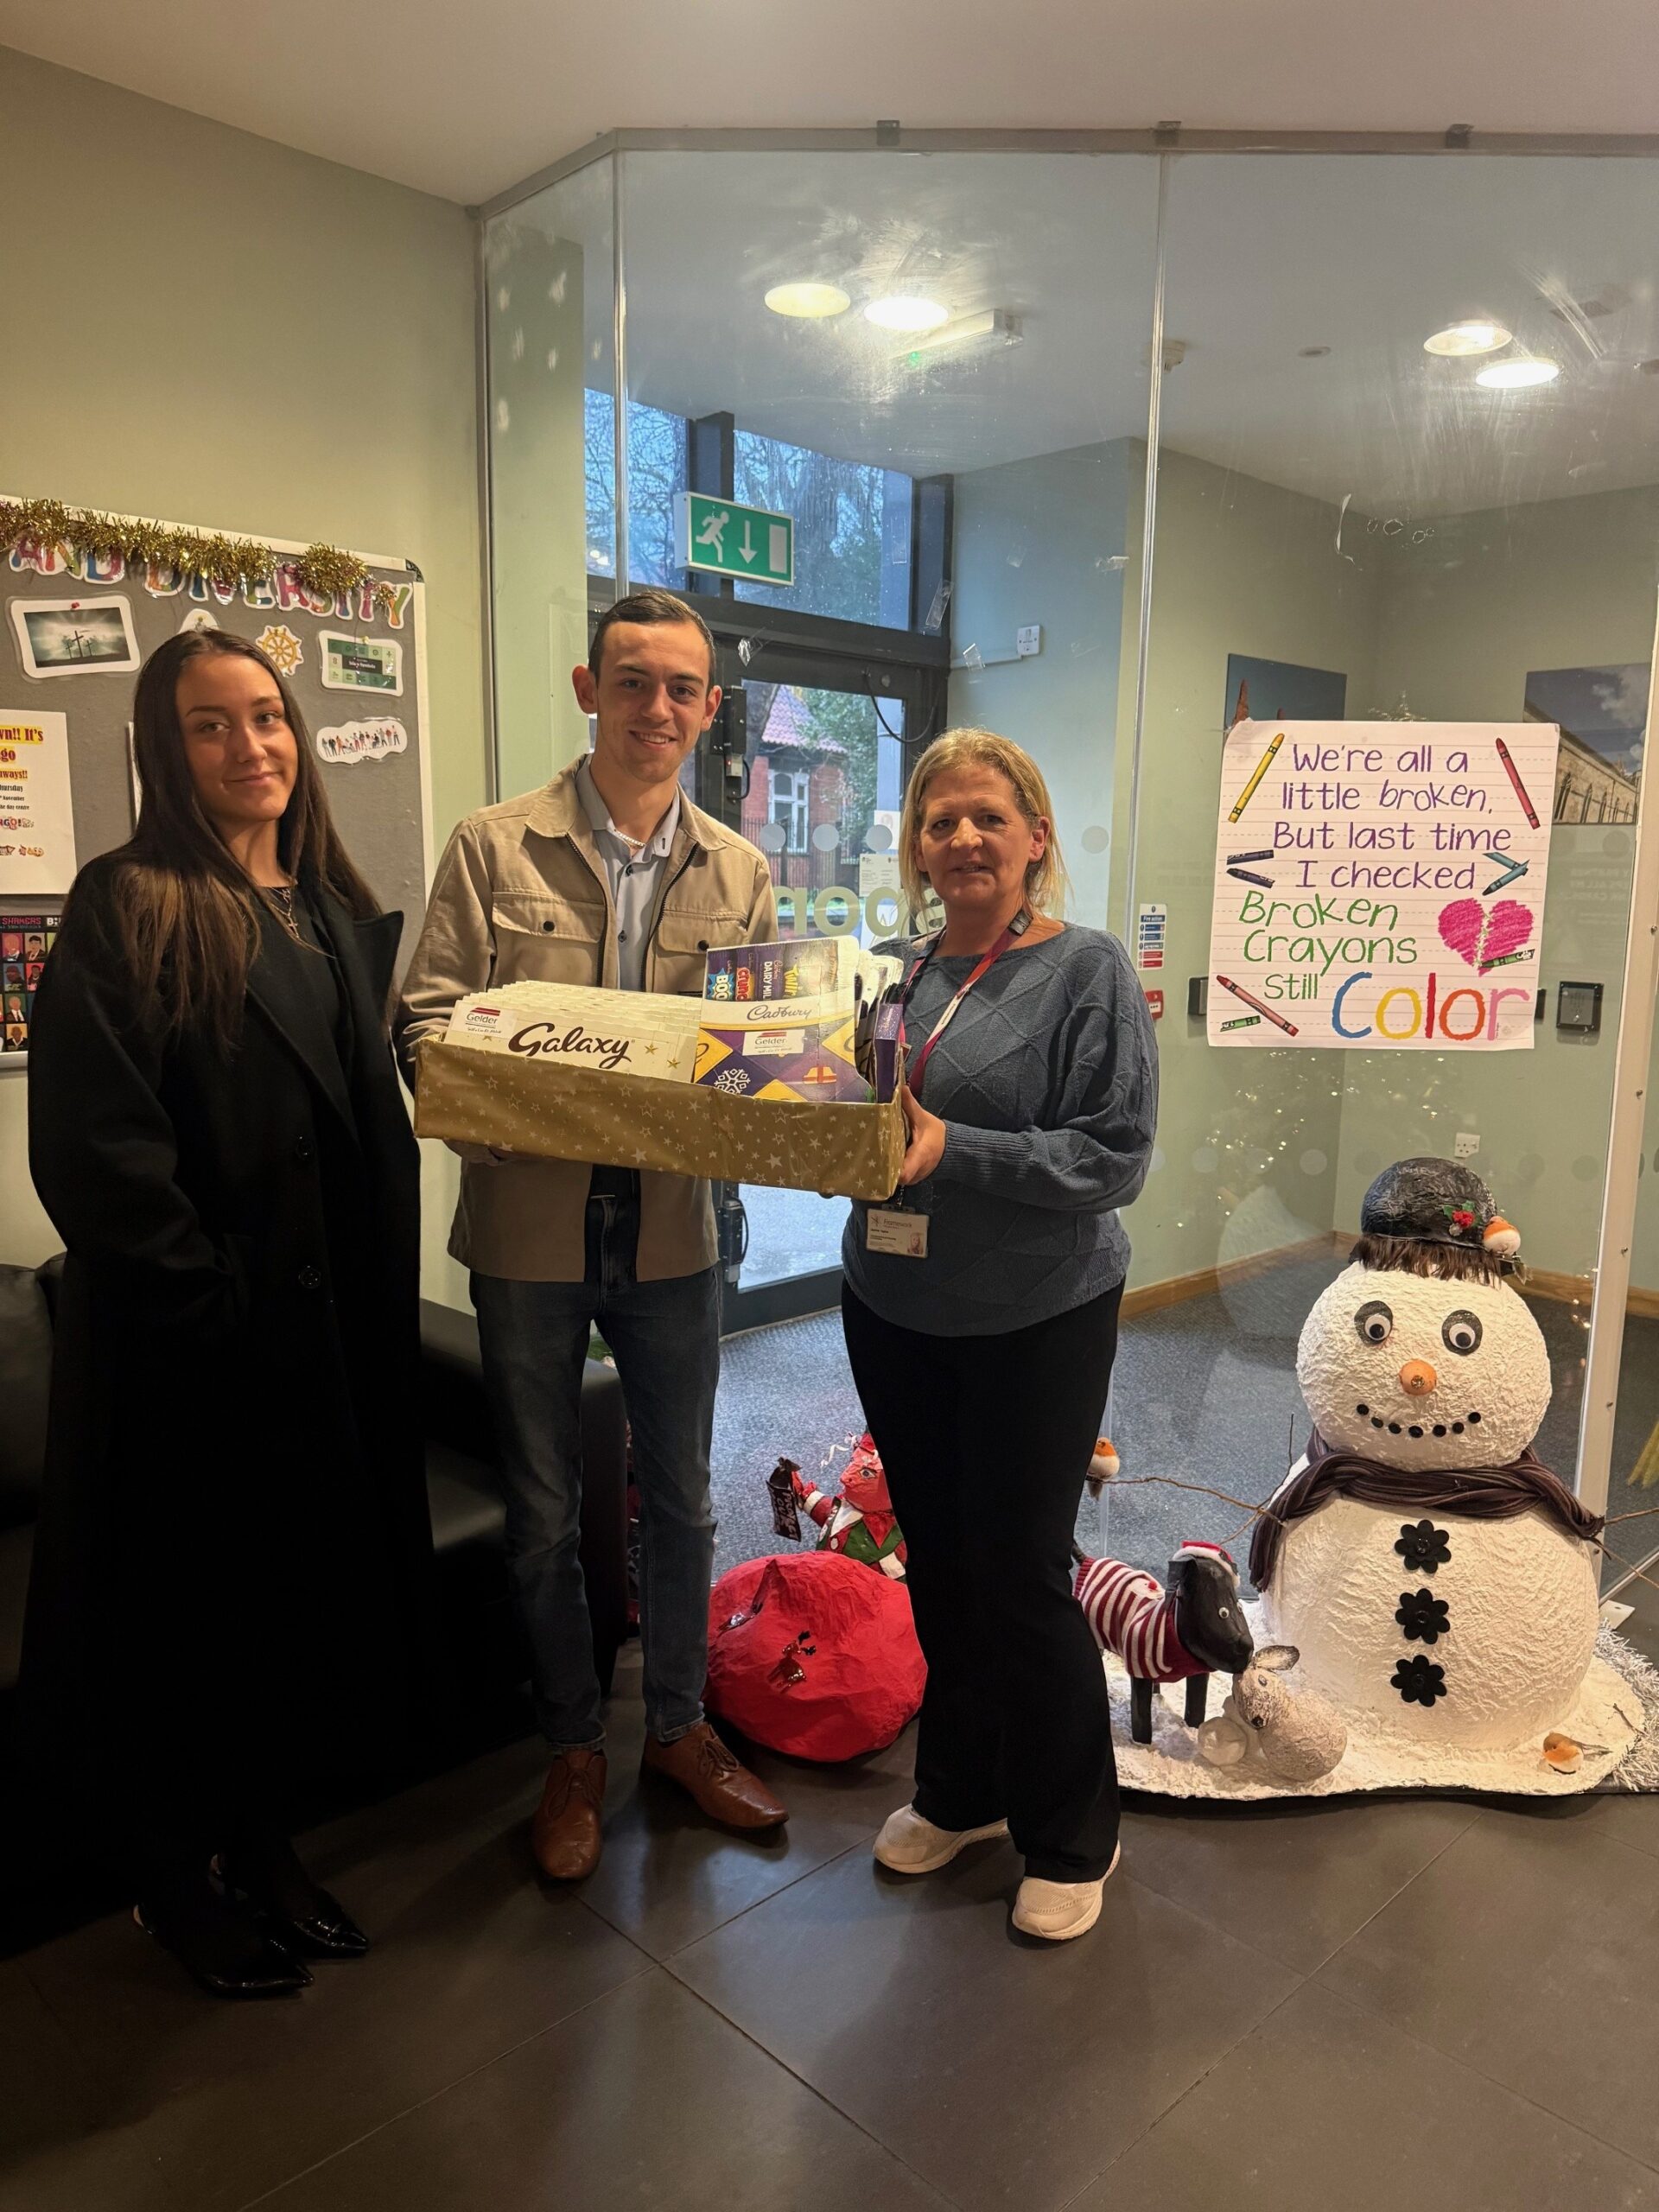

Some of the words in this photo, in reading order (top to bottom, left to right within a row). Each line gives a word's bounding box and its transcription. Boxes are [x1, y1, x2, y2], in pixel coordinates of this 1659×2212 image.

[24, 728, 44, 742] It's
[1294, 744, 1382, 772] We're
[1397, 745, 1433, 772] all
[1446, 752, 1468, 772] a
[1282, 782, 1360, 810] little
[1379, 779, 1493, 814] broken,
[1274, 822, 1334, 850] But
[1349, 822, 1414, 850] last
[1430, 823, 1511, 851] time
[1295, 860, 1319, 888] I
[1331, 861, 1476, 889] checked
[1239, 890, 1398, 931] Broken
[1244, 930, 1417, 976] Crayons
[763, 961, 773, 985] DAIRY
[466, 1013, 499, 1026] Gelder
[747, 1004, 812, 1020] Cadbury
[1264, 973, 1319, 1001] Still
[1332, 971, 1529, 1041] Color
[508, 1022, 632, 1070] Galaxy
